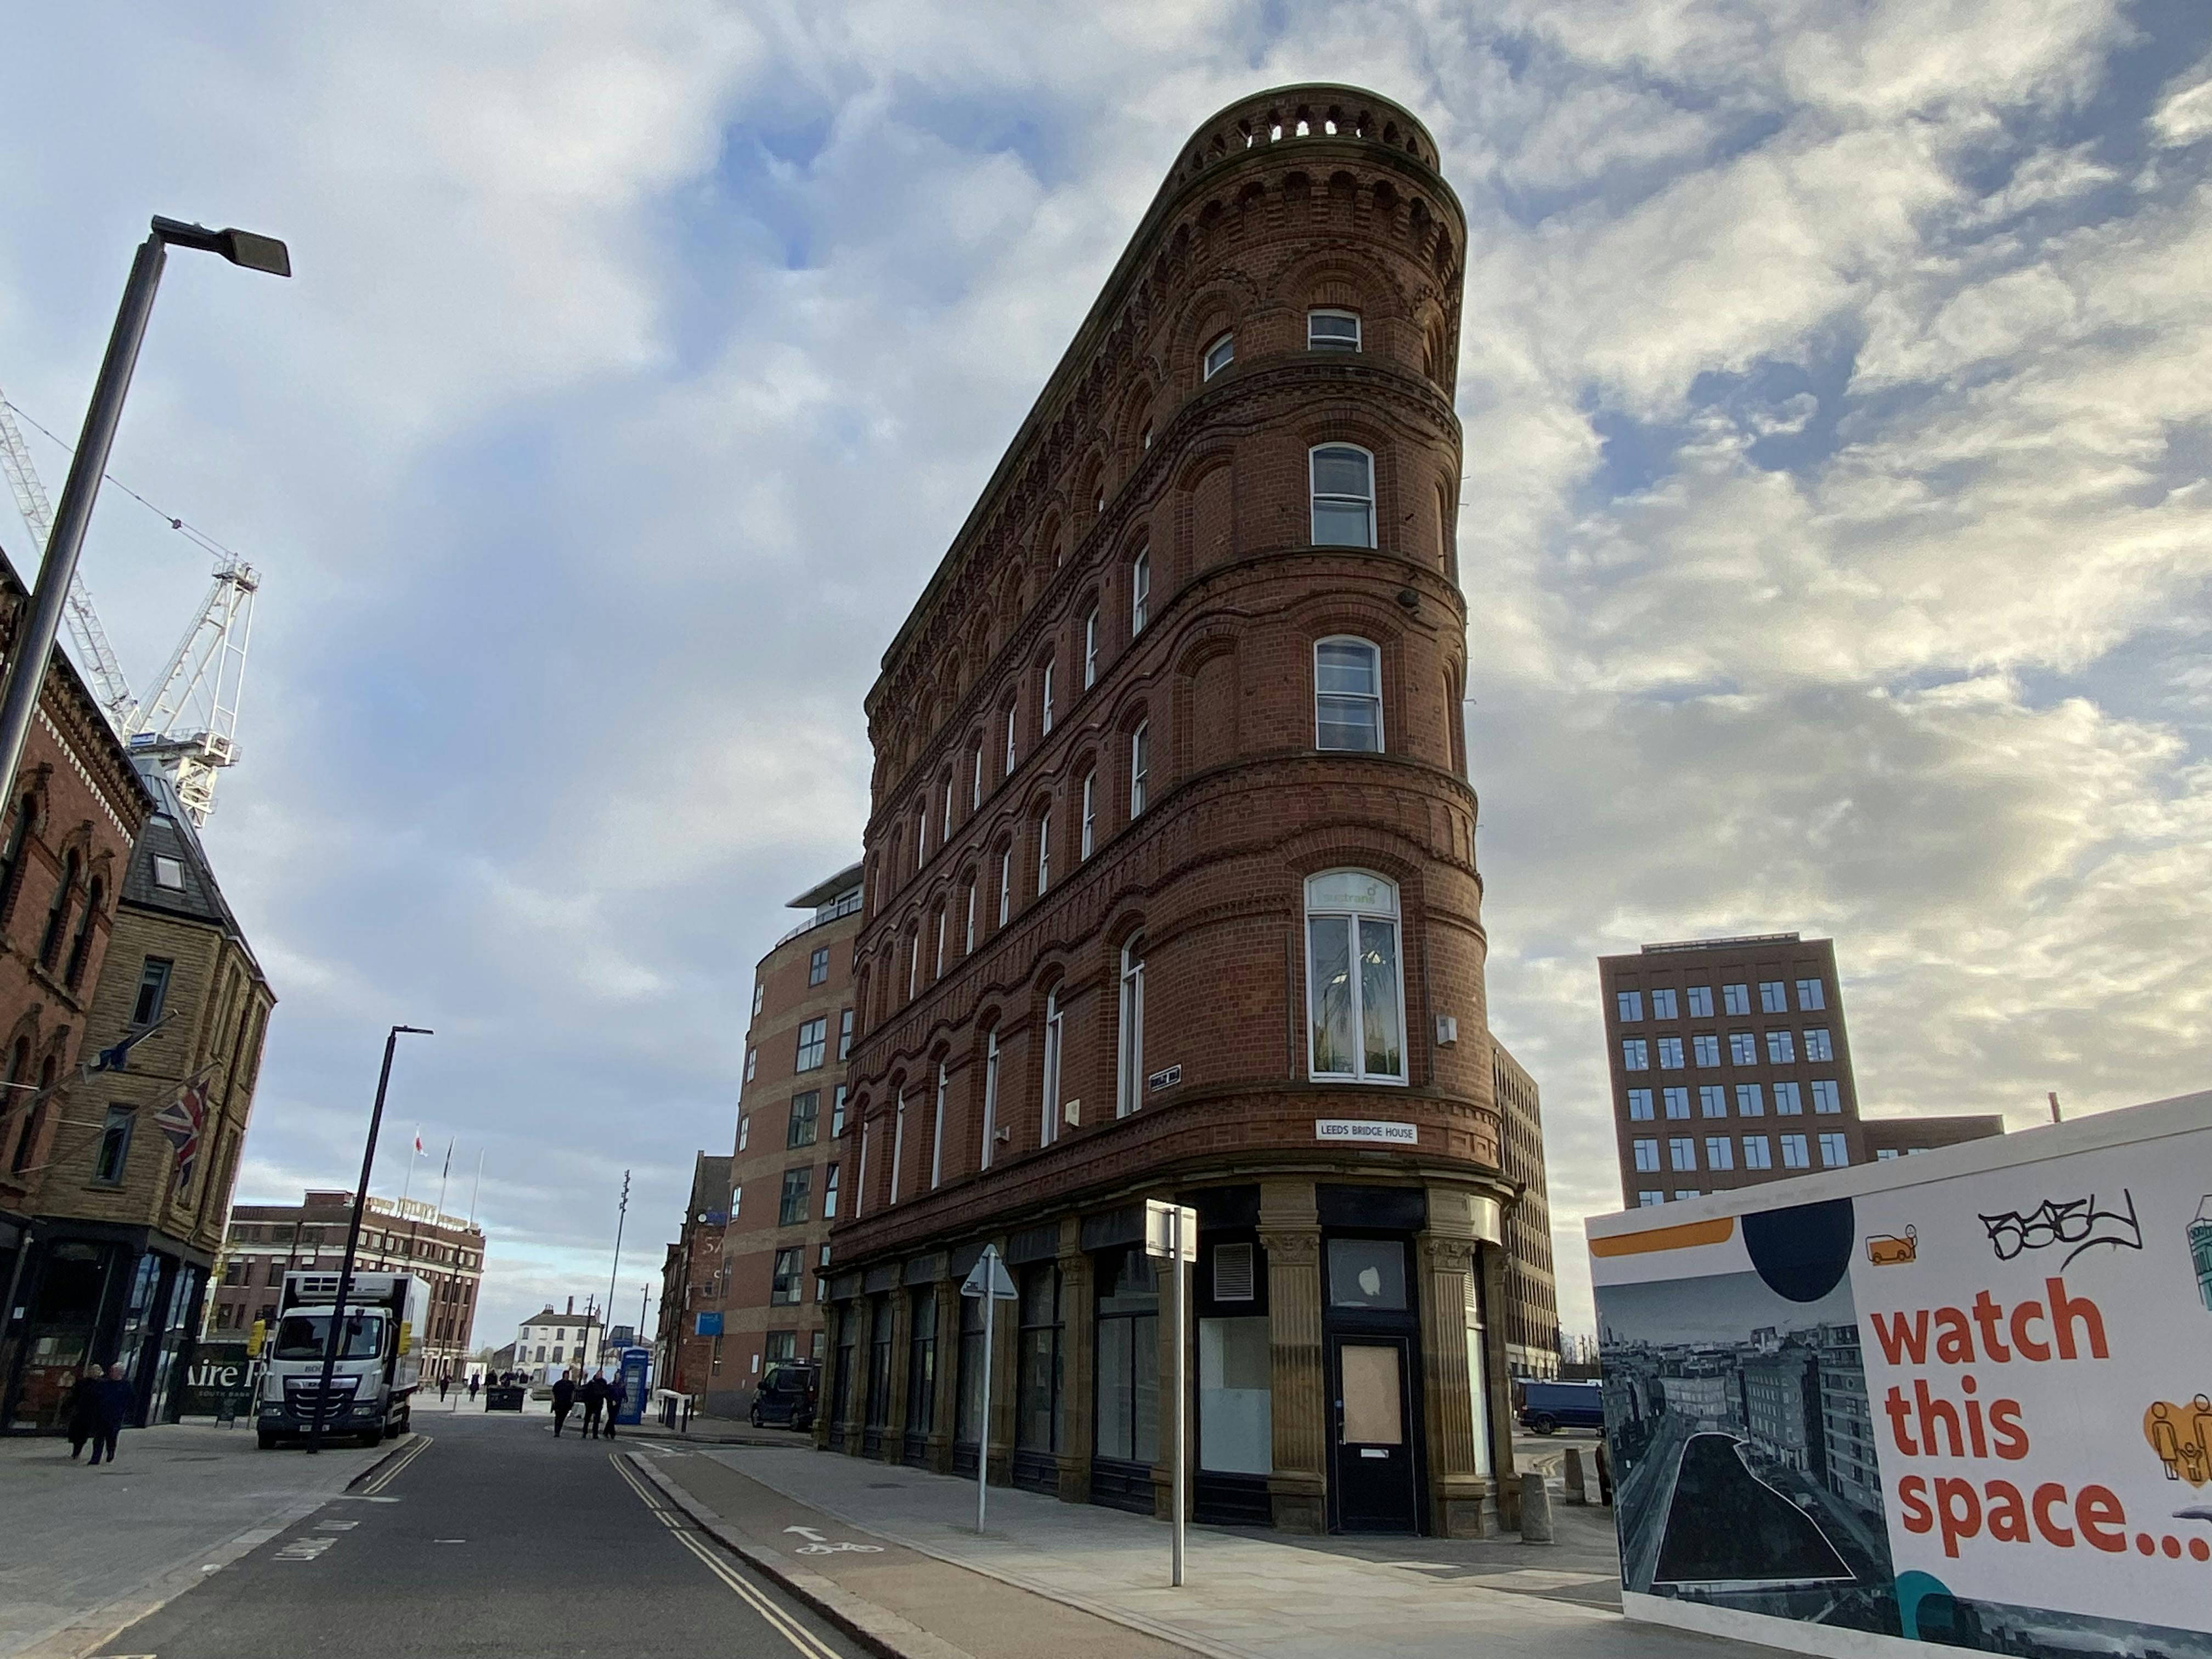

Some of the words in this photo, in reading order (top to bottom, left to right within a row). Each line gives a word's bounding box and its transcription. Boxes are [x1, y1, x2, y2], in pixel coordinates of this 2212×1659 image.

[1324, 893, 1375, 905] sustrans
[1321, 1125, 1348, 1135] LEEDS
[1352, 1125, 1383, 1136] BRIDGE
[1385, 1127, 1413, 1138] HOUSE
[1870, 1277, 2110, 1365] watch
[1884, 1375, 2030, 1460] this
[1898, 1475, 2210, 1561] space...
